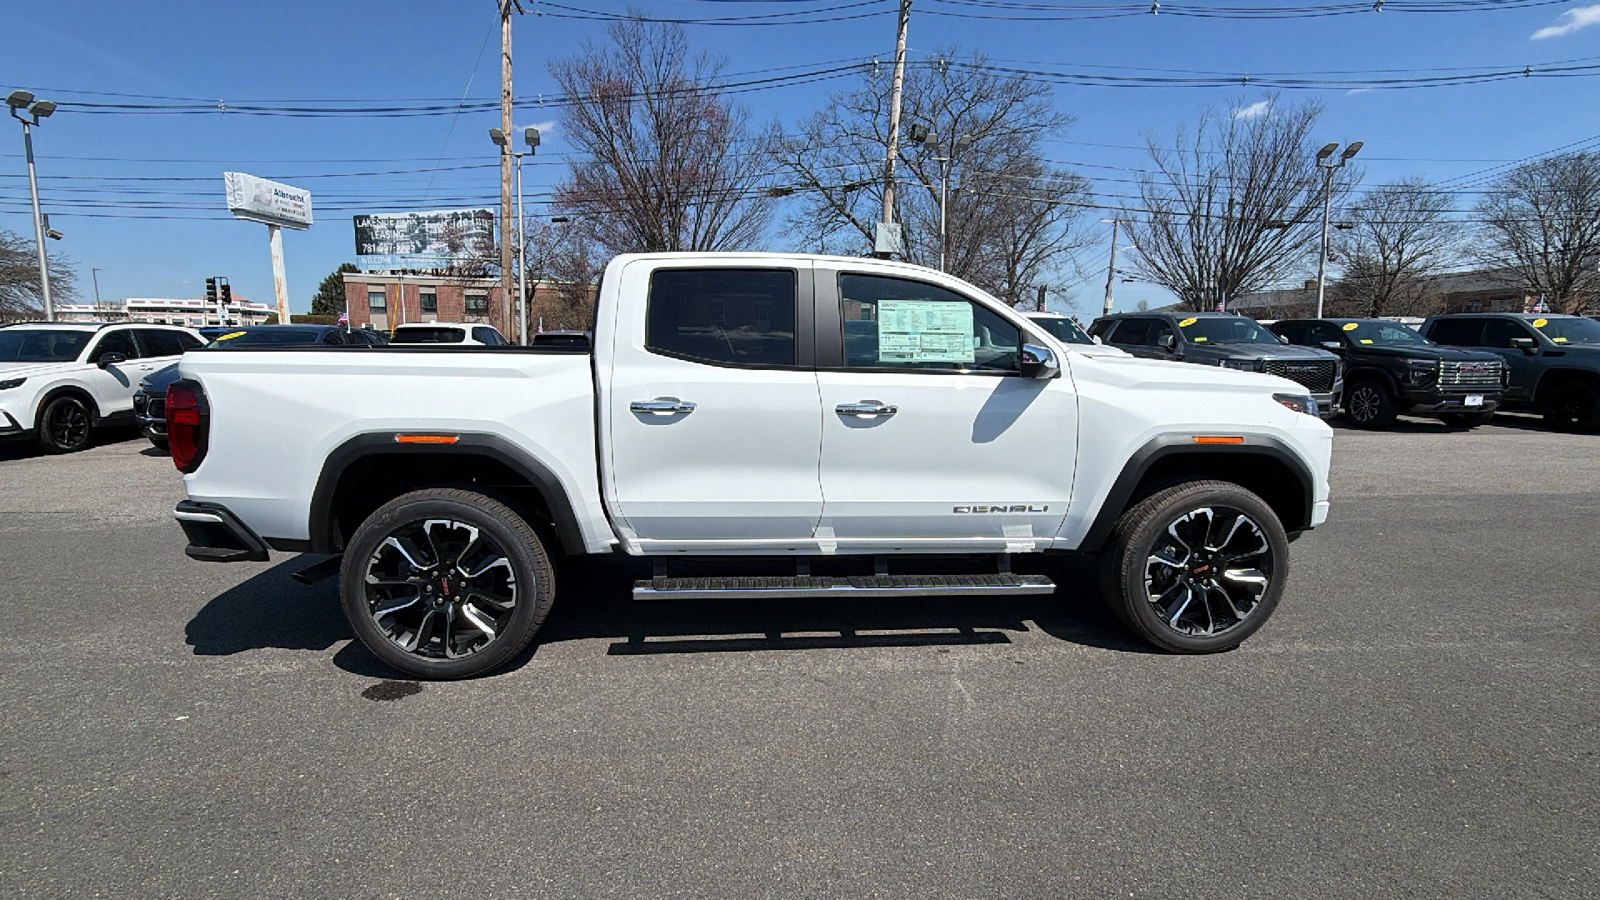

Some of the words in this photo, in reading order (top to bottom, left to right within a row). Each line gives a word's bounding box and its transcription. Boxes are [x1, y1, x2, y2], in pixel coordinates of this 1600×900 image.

[274, 188, 305, 203] Albrecht
[356, 219, 395, 228] LAKESIDE
[370, 230, 404, 240] LEASING
[952, 504, 1049, 514] DENALI
